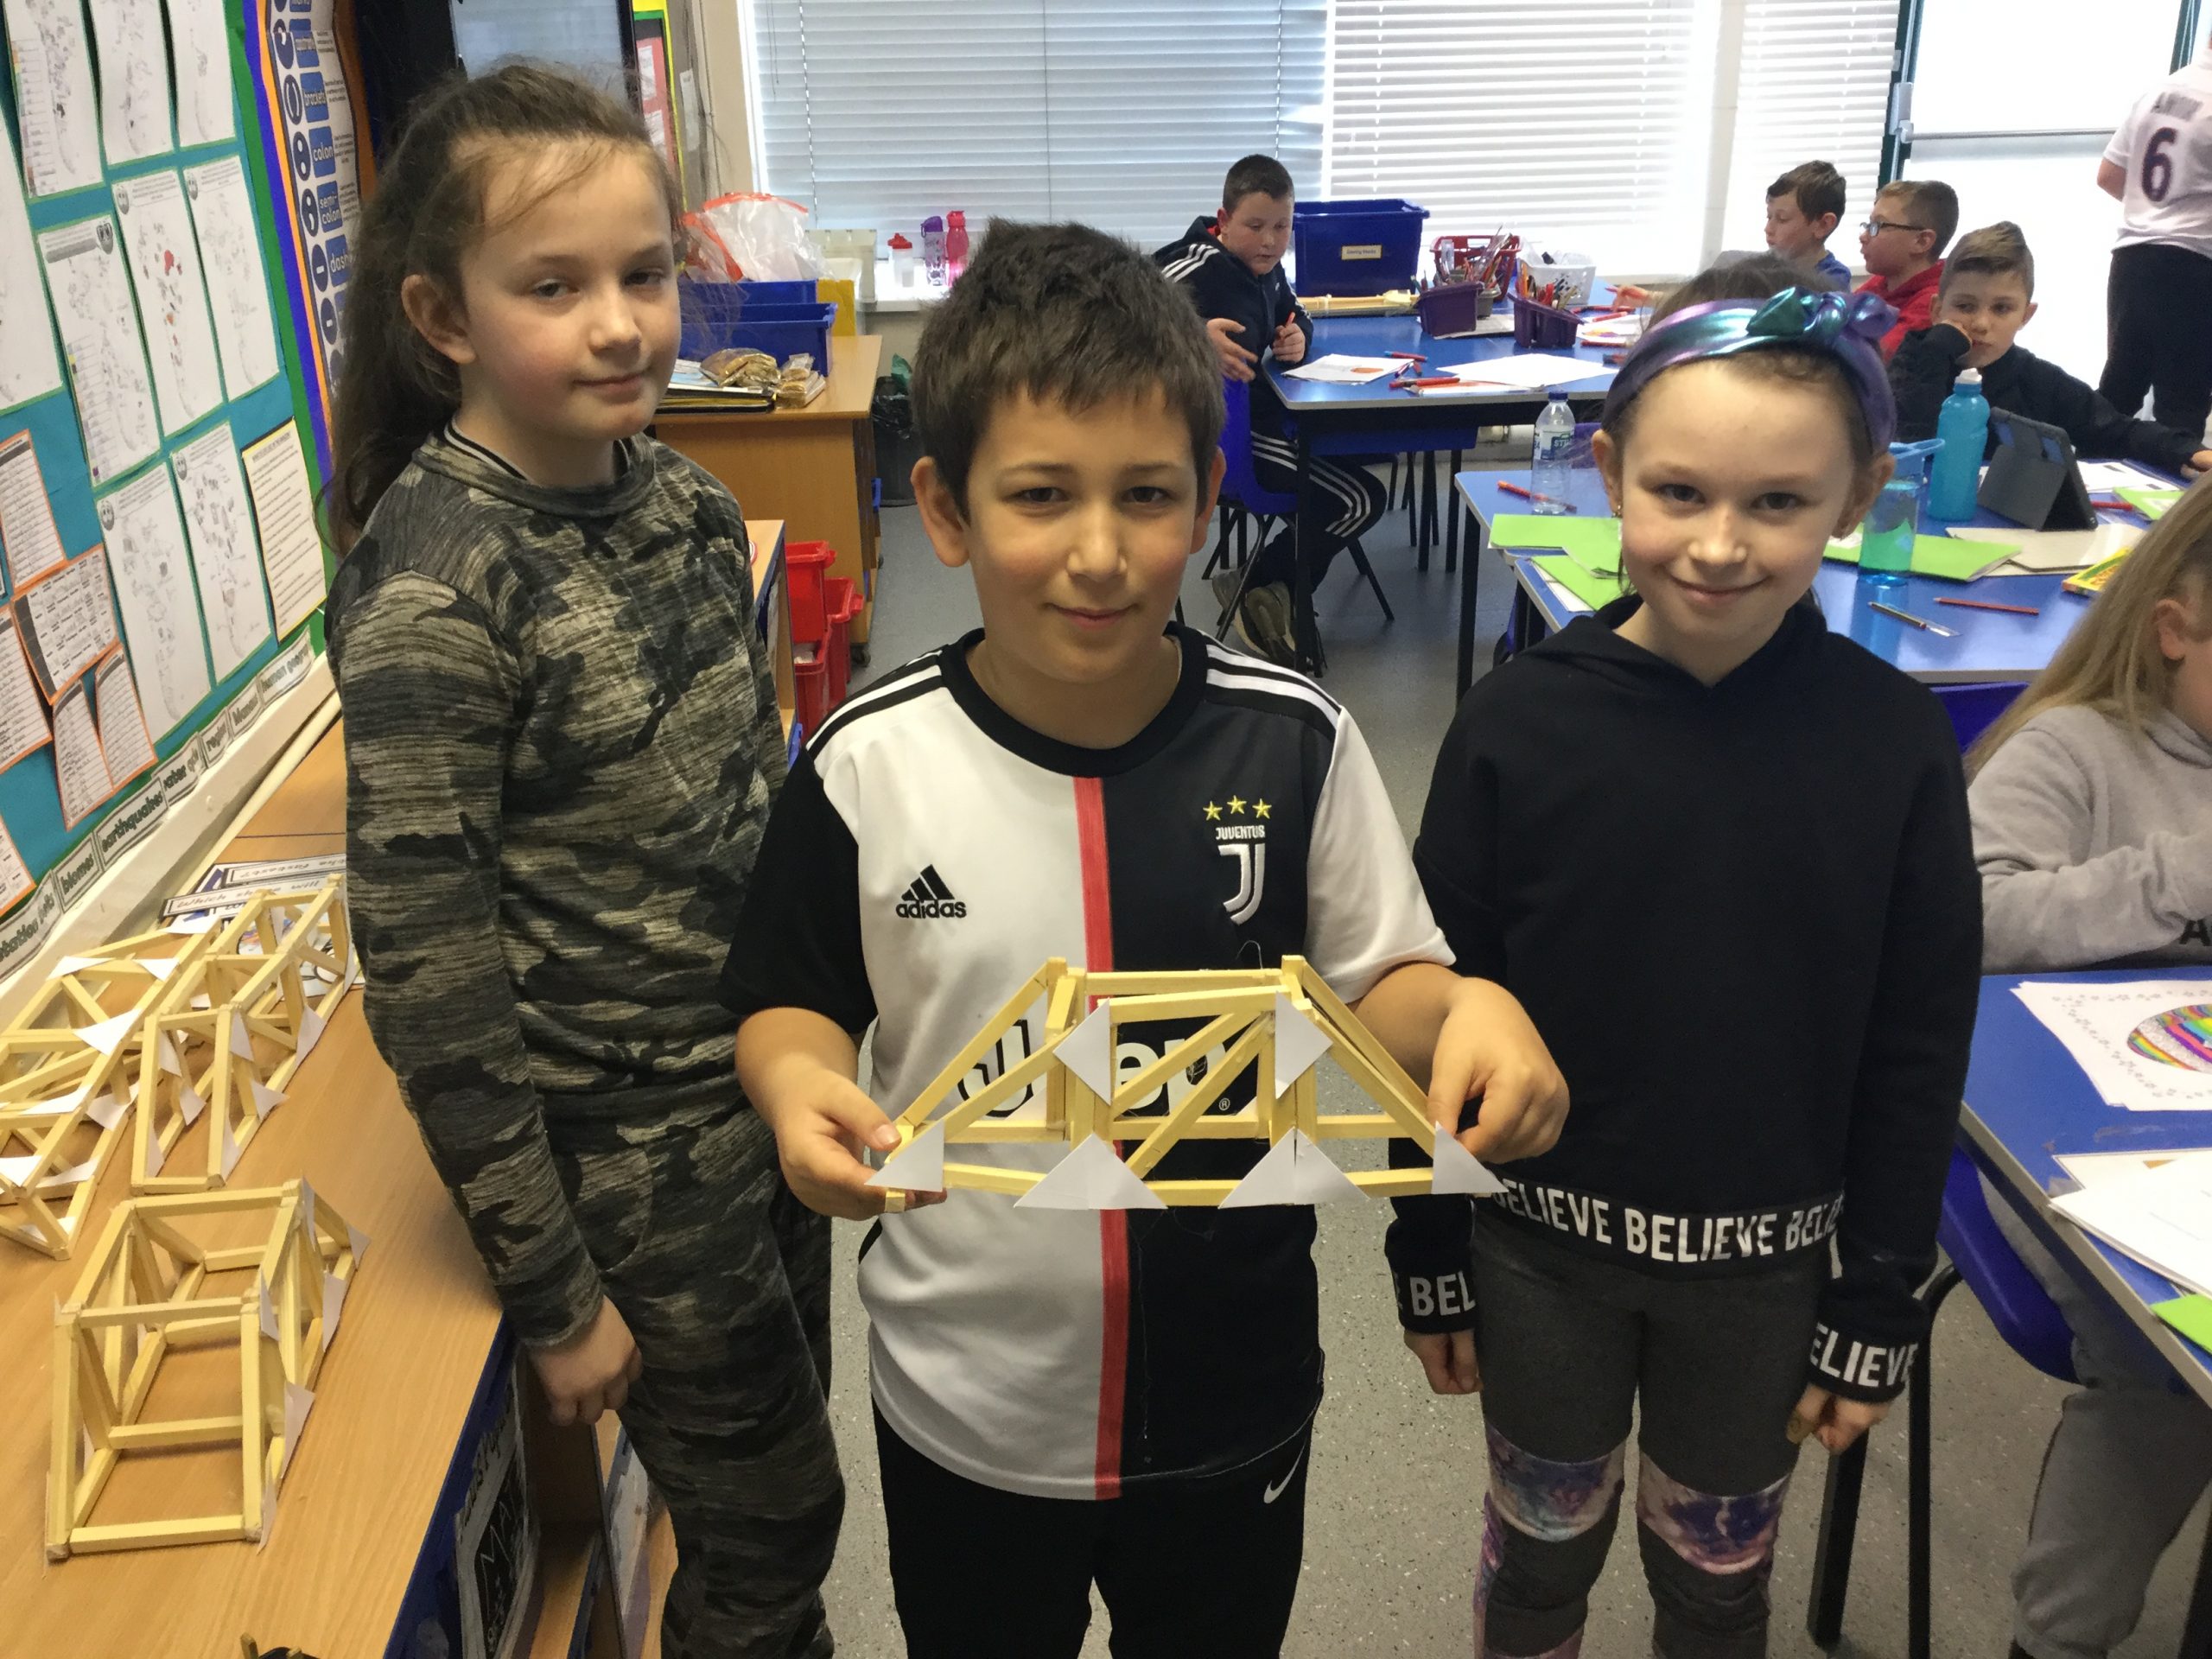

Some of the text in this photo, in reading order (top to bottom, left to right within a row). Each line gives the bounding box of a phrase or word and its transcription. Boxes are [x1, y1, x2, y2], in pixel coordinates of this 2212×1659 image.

[304, 90, 327, 108] brackets
[313, 141, 334, 162] colon
[2142, 127, 2177, 202] 6
[320, 194, 338, 208] semi-
[321, 207, 341, 226] colon
[101, 790, 164, 854] earthquakes
[1216, 824, 1266, 841] JUVENTUS
[60, 853, 94, 896] biomes
[177, 893, 227, 909] Which
[895, 899, 967, 919] adidas
[1624, 1208, 1778, 1262] BELIEVE
